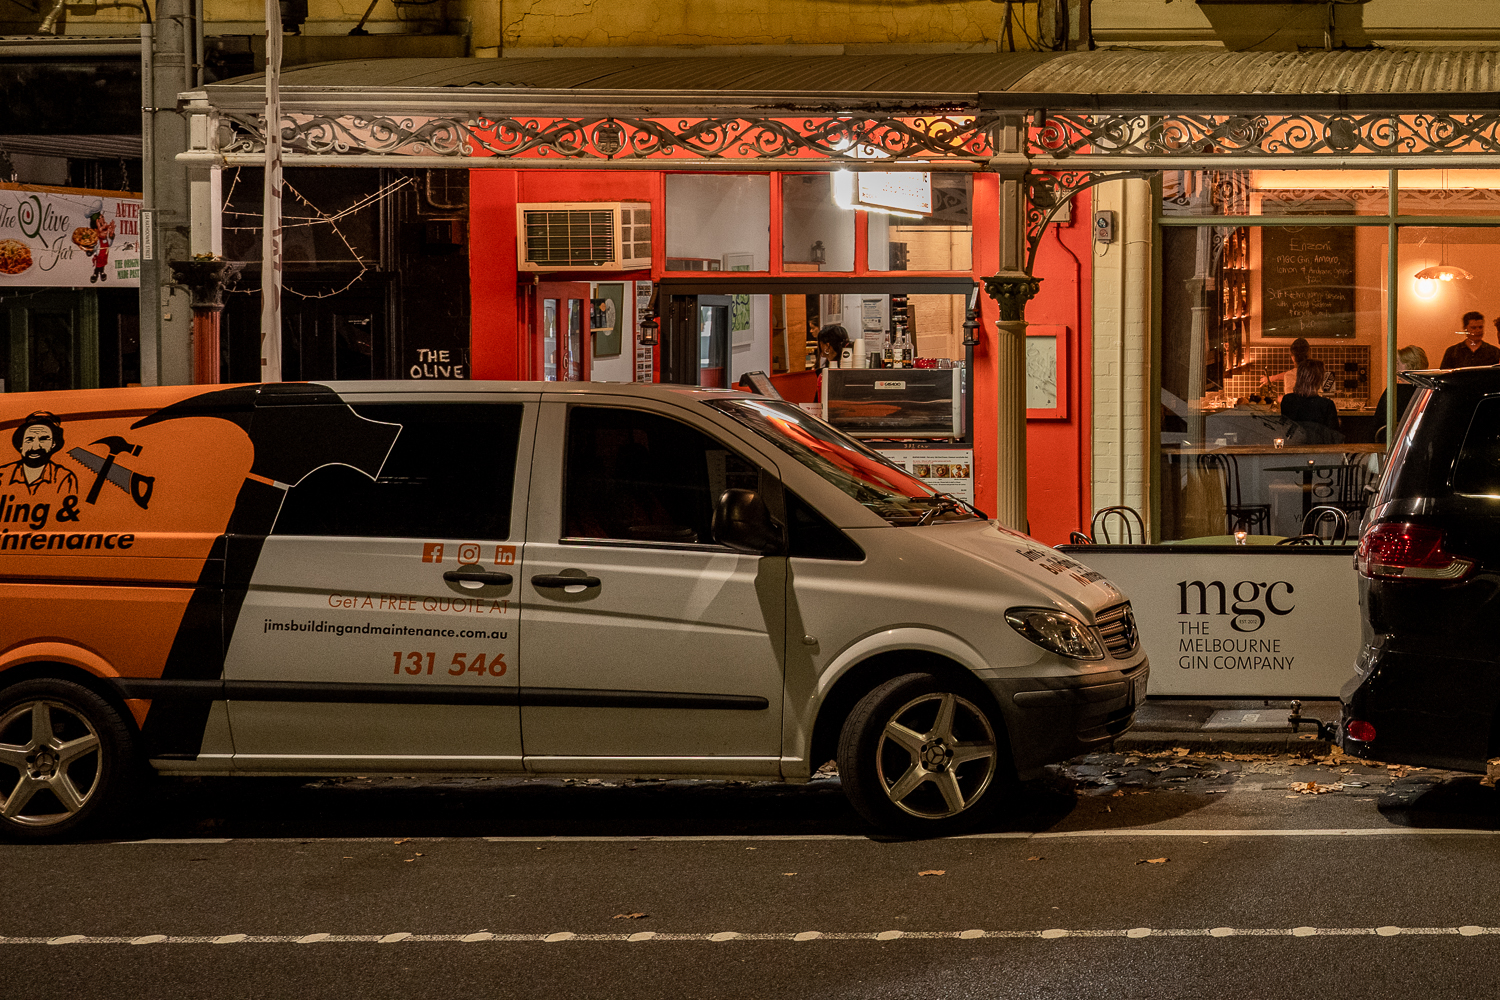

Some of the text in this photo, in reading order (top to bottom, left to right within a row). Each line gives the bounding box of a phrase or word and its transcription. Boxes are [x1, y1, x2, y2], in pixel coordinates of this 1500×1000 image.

[18, 195, 70, 248] Olive
[416, 348, 450, 363] THE
[410, 363, 464, 379] OLIVE
[328, 593, 511, 614] Get A FREE QUOTE AT
[1176, 580, 1296, 633] mgc
[263, 619, 508, 640] jimsbuildingandmaintenance.com.au
[1178, 621, 1210, 635] THE
[1179, 638, 1281, 653] MELBOURNE
[393, 651, 507, 677] 131 546
[1179, 655, 1295, 671] GIN COMPANY
